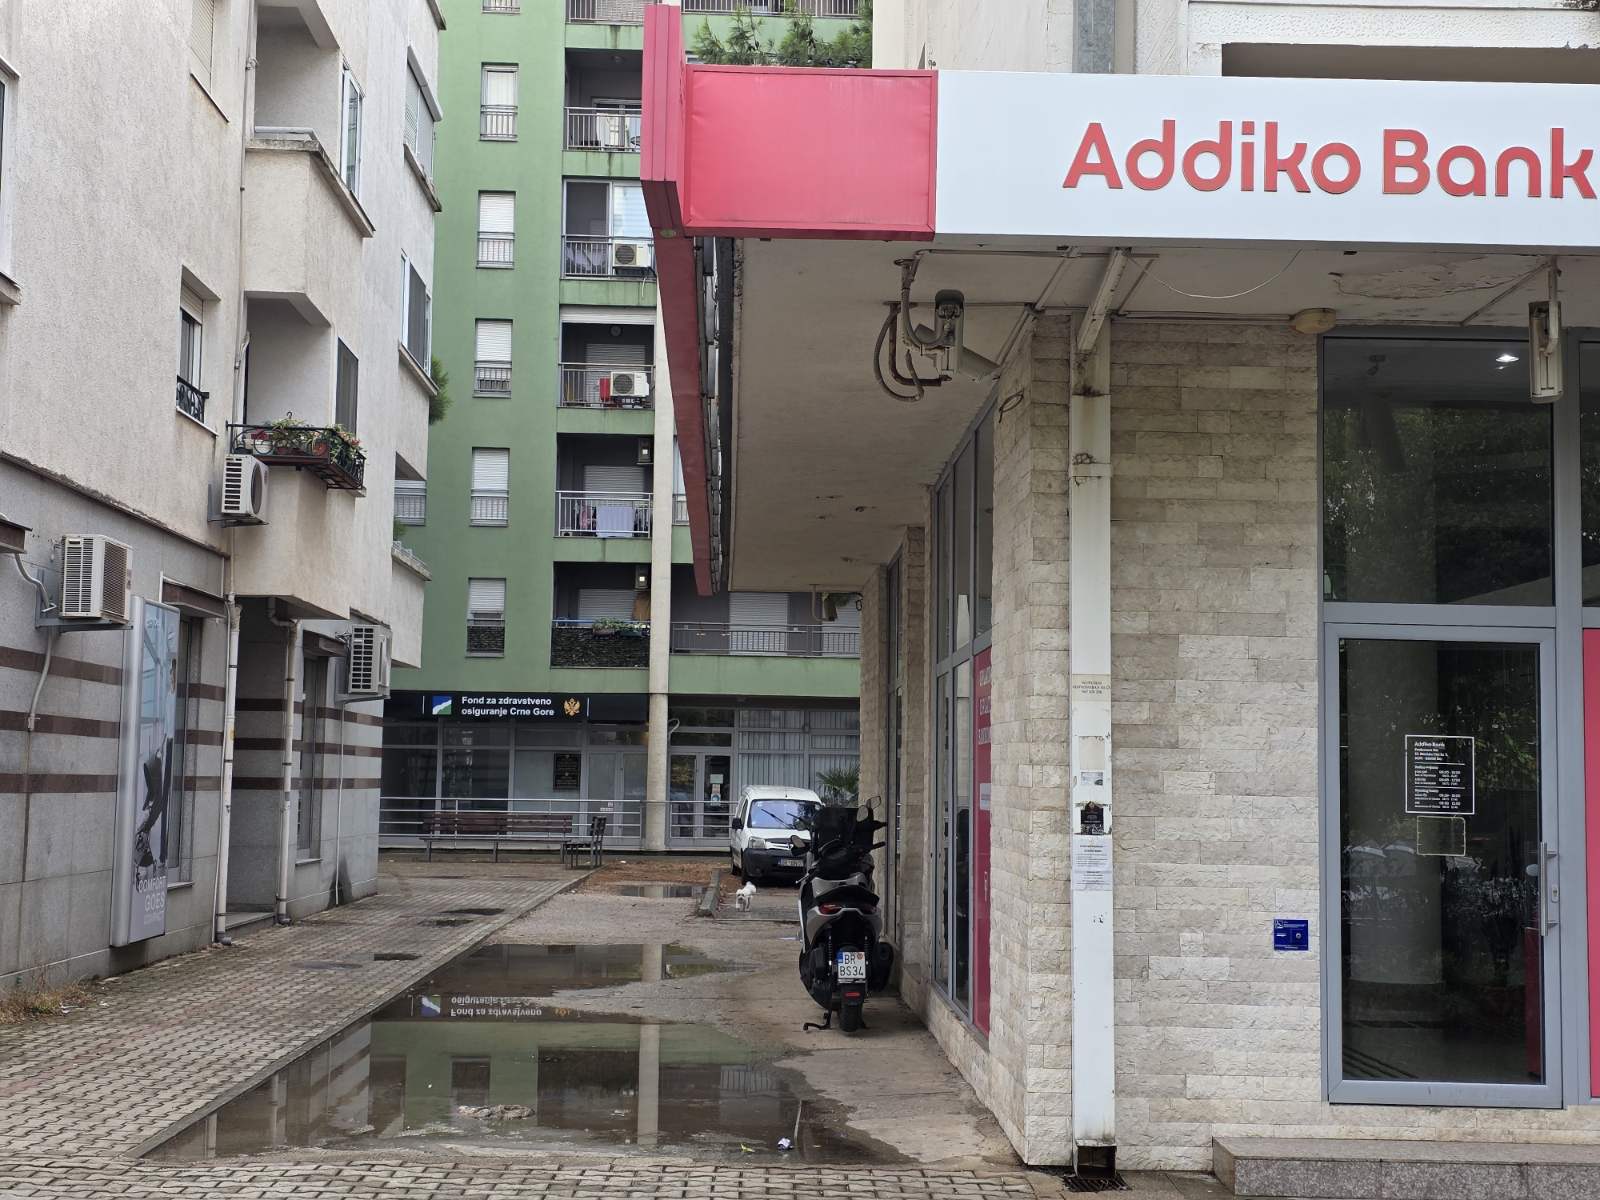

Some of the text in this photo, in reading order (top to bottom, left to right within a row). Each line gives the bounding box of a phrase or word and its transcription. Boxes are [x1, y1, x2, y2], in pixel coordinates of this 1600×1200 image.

[1062, 119, 1597, 199] Addiko Bank
[461, 696, 485, 705] Fond
[498, 697, 552, 705] zdravstveno
[461, 707, 555, 717] osiguranje Crne Gore
[144, 891, 166, 912] GOES
[844, 954, 856, 965] BR
[839, 965, 864, 977] BS34
